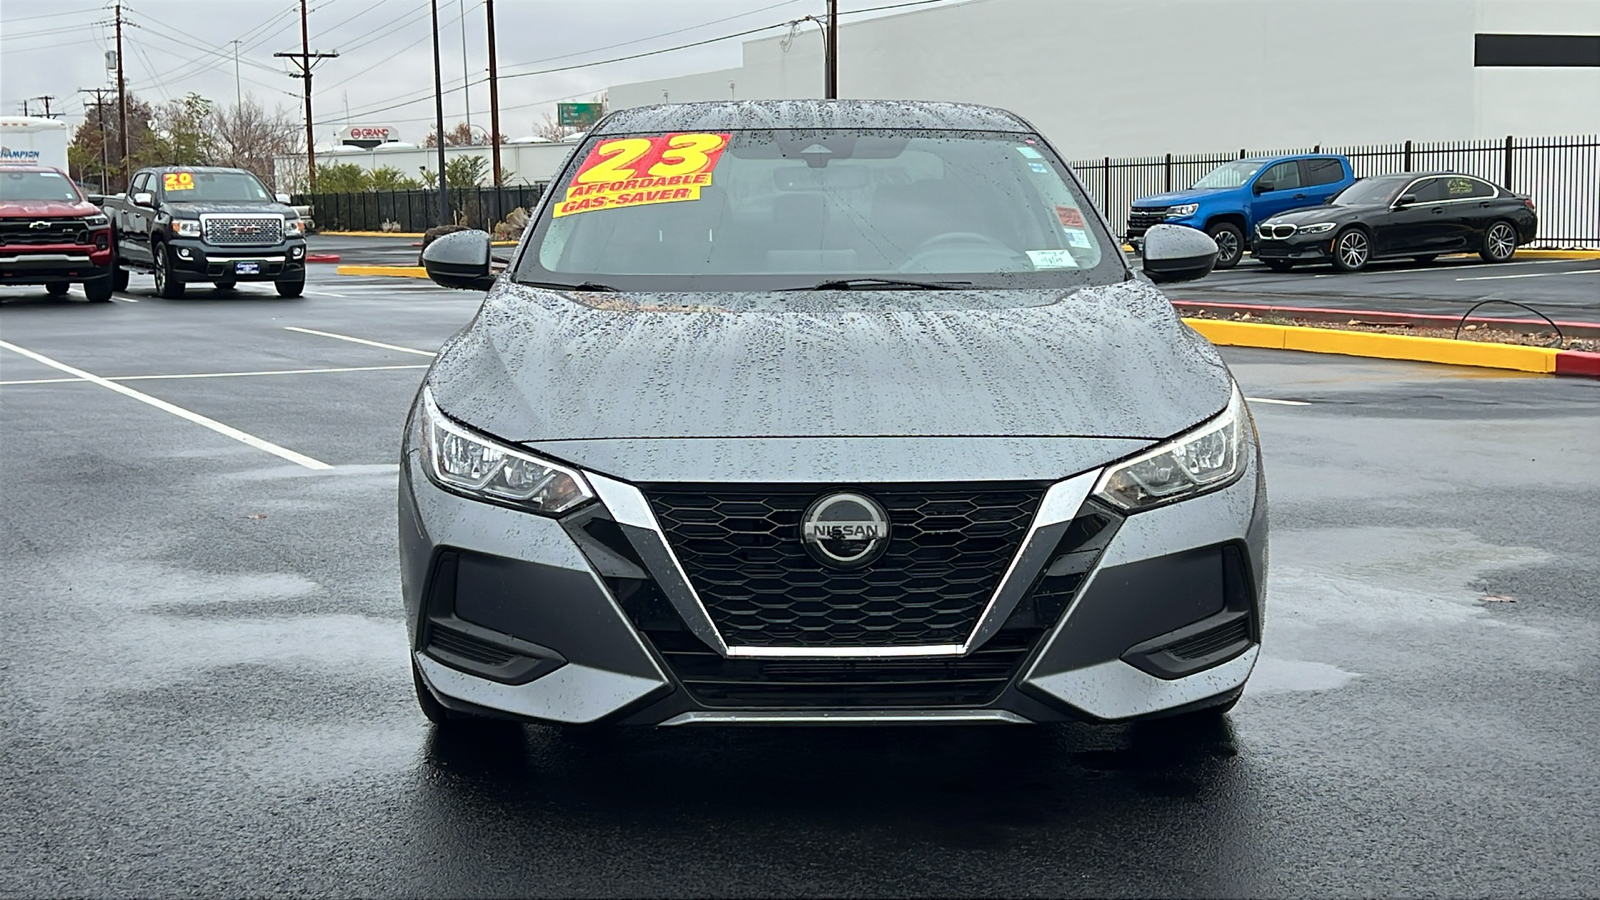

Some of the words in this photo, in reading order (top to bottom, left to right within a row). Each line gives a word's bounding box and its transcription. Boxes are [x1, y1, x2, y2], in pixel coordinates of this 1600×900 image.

[362, 128, 389, 137] GRAND
[577, 133, 726, 184] 23
[165, 173, 192, 185] 20
[569, 173, 710, 199] AFFORDABLE
[561, 187, 692, 214] GAS-SAVER
[813, 525, 879, 537] NISSAN
